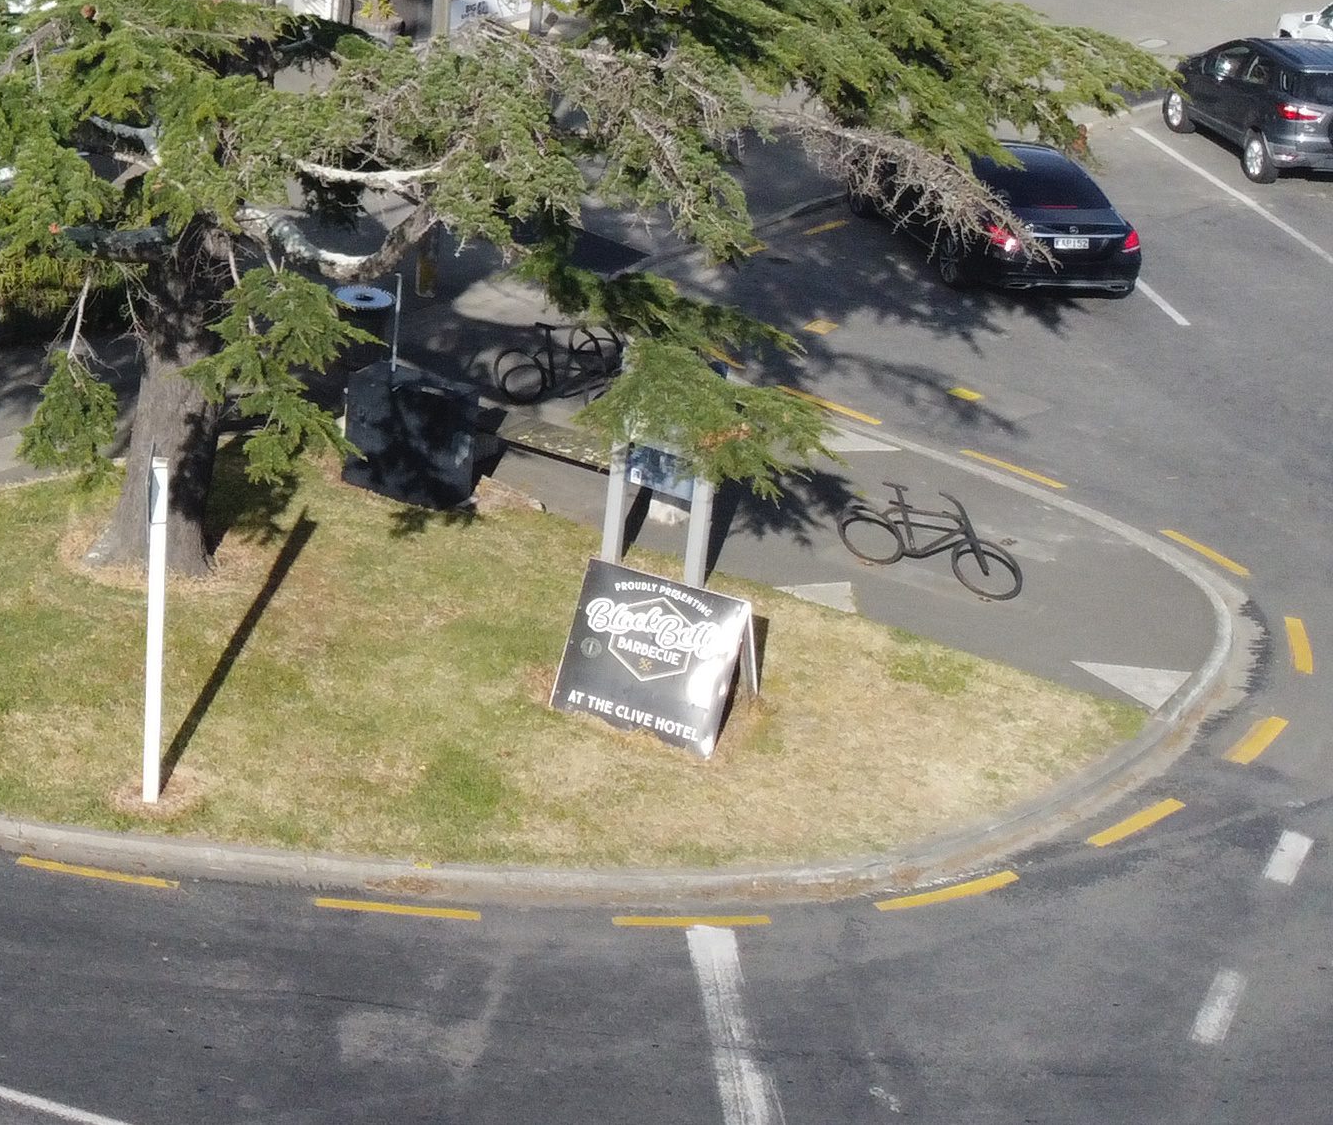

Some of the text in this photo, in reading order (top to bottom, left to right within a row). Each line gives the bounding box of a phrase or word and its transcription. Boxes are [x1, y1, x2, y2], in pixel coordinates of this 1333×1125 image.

[585, 597, 664, 635] Black
[614, 580, 715, 618] PROUDLY PRESENTING
[616, 635, 682, 666] BARBECUE
[567, 689, 700, 742] AT THE CLIVE HOTEL
